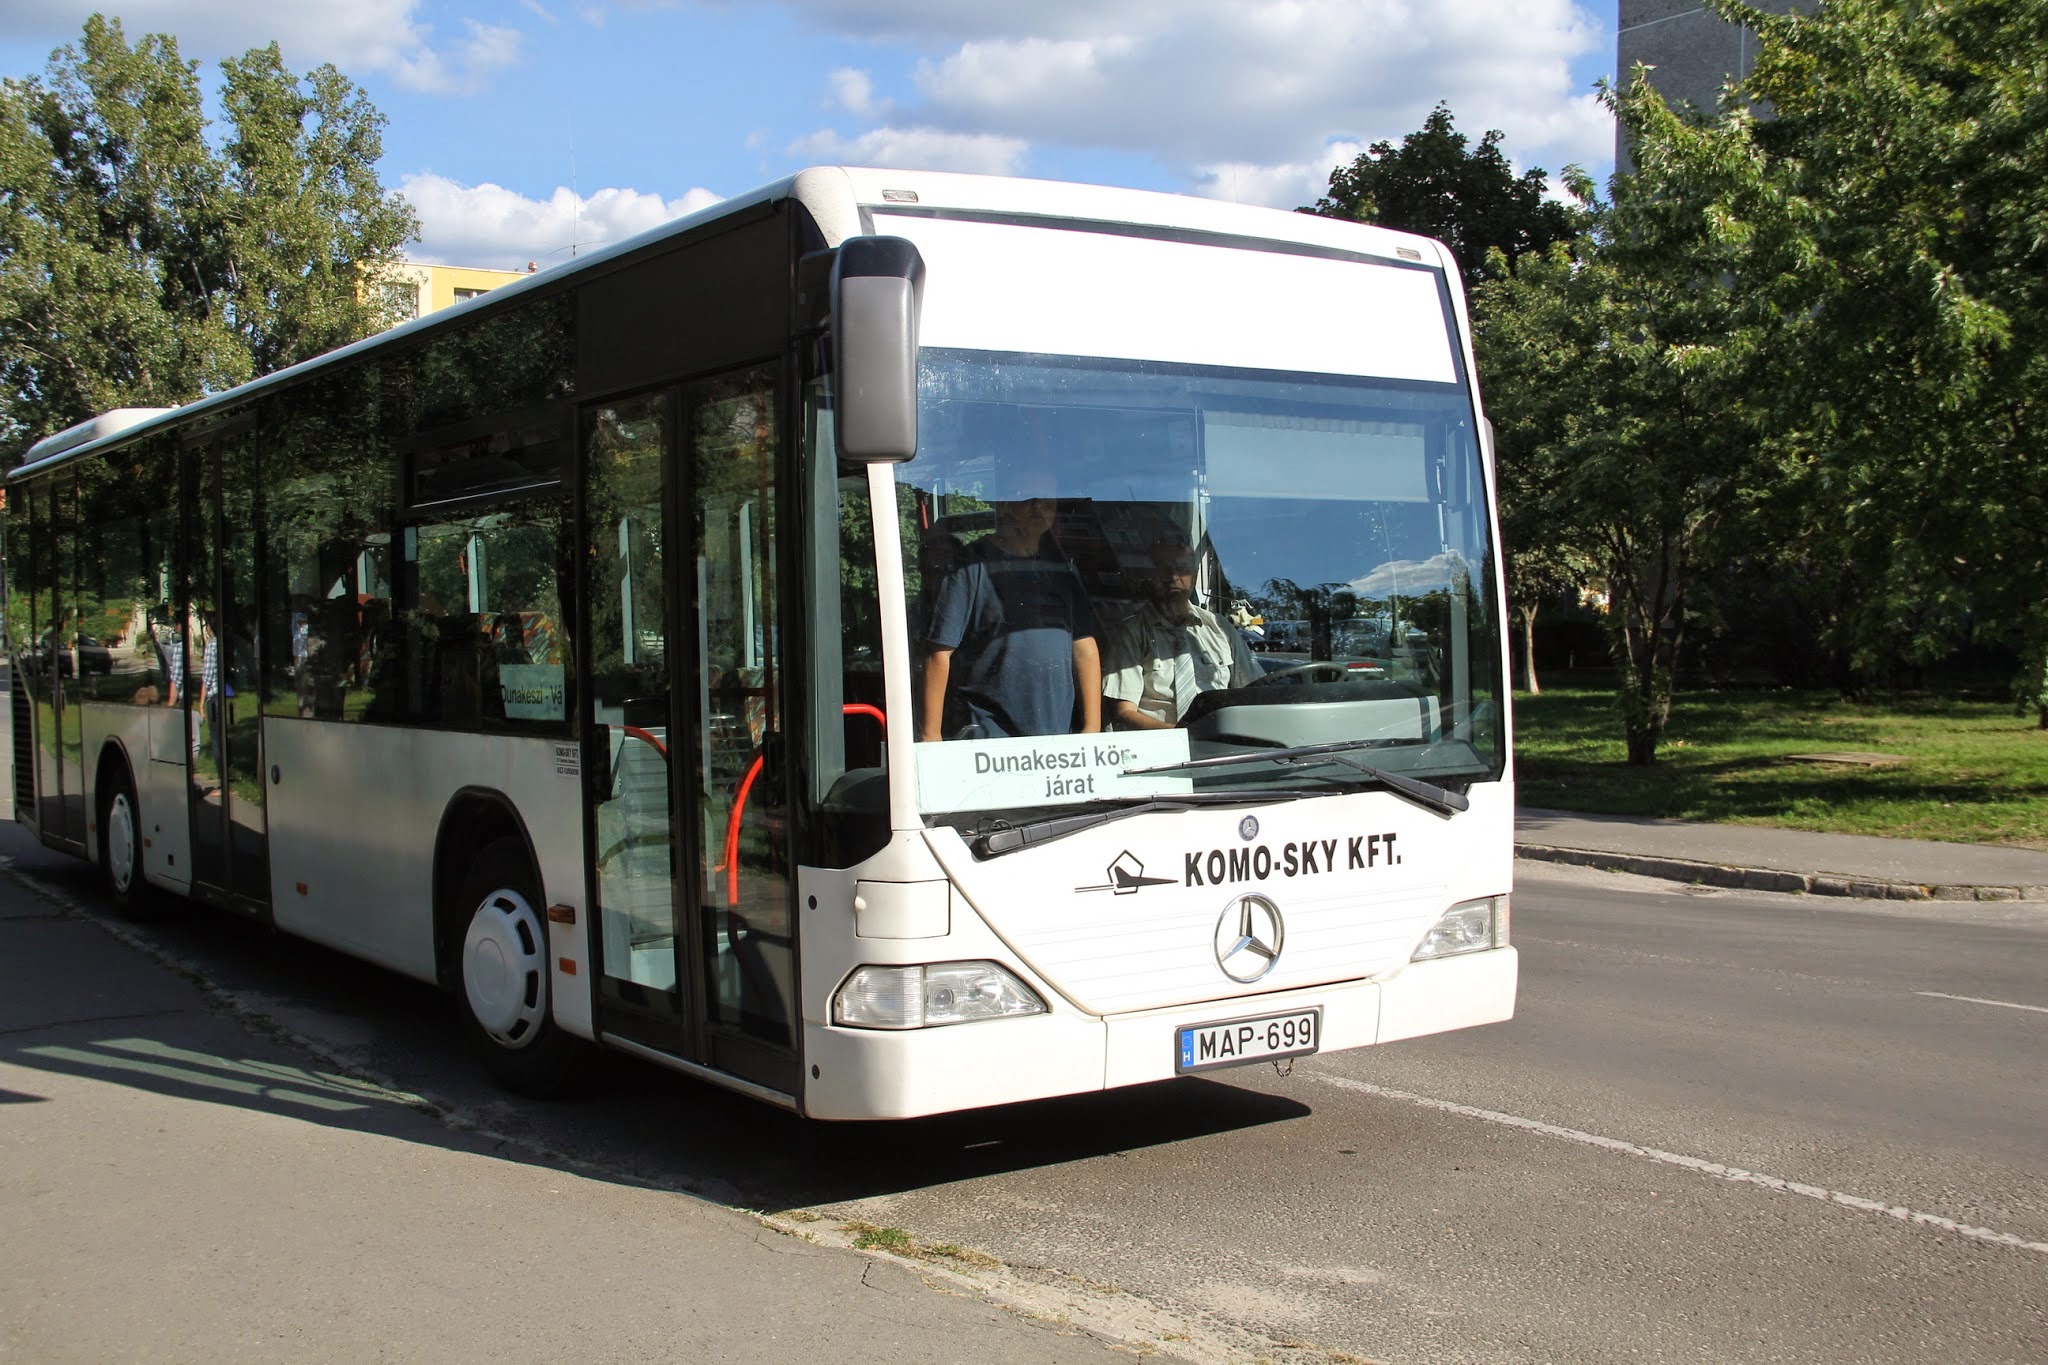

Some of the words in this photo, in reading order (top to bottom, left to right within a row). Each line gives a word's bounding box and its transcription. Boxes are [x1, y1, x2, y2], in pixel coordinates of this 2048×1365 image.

[974, 746, 1087, 774] Dunakeszi
[1094, 745, 1138, 767] kör-
[1045, 773, 1095, 798] járat
[1185, 839, 1338, 887] KOMO-SKY
[1348, 832, 1402, 870] KFT.
[1200, 1018, 1311, 1060] MAP-699
[1183, 1051, 1191, 1062] H
